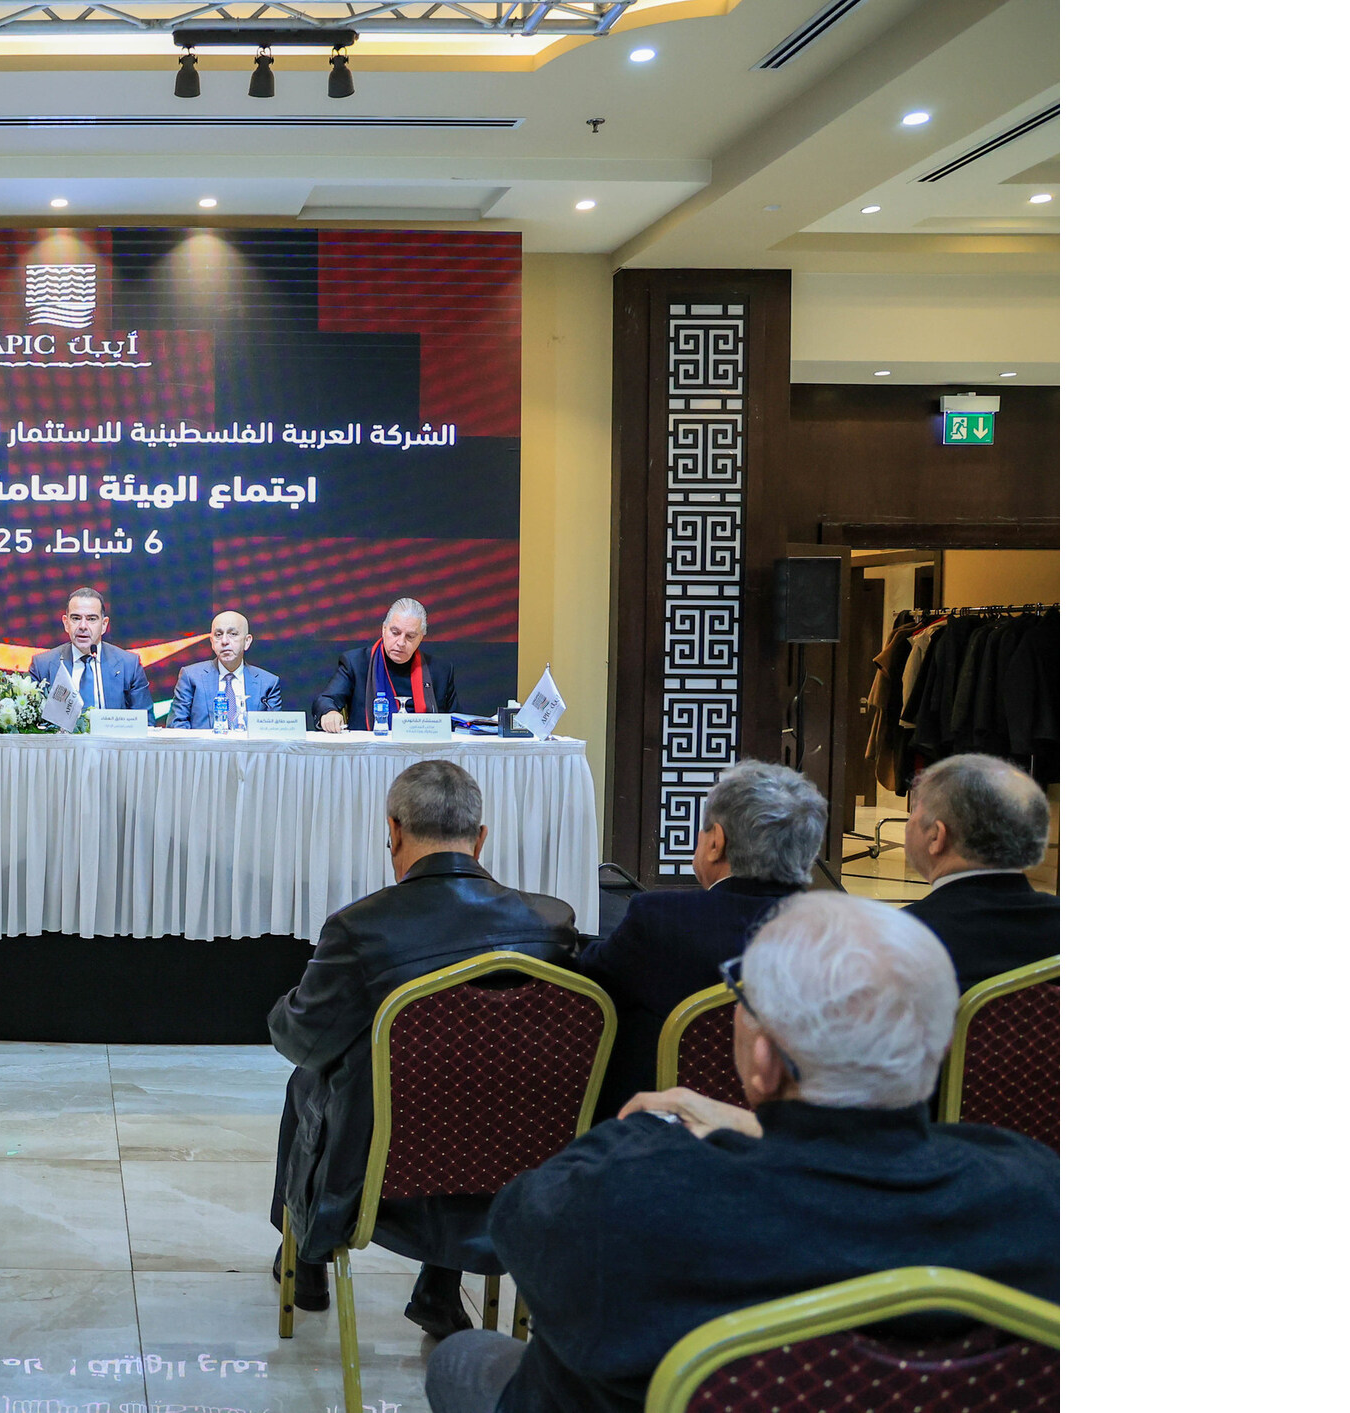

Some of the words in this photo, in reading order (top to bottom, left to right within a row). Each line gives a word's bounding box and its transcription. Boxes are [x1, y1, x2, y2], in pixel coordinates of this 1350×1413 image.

[6, 420, 122, 448] للاستثمار
[130, 421, 273, 448] الفلسطينية
[282, 423, 361, 449] العربية
[369, 423, 455, 450] الشركة
[99, 474, 198, 509] الهيئة
[208, 476, 317, 510] اجتماع
[144, 529, 163, 555] 6
[65, 699, 74, 716] APIC
[541, 708, 552, 725] APIC
